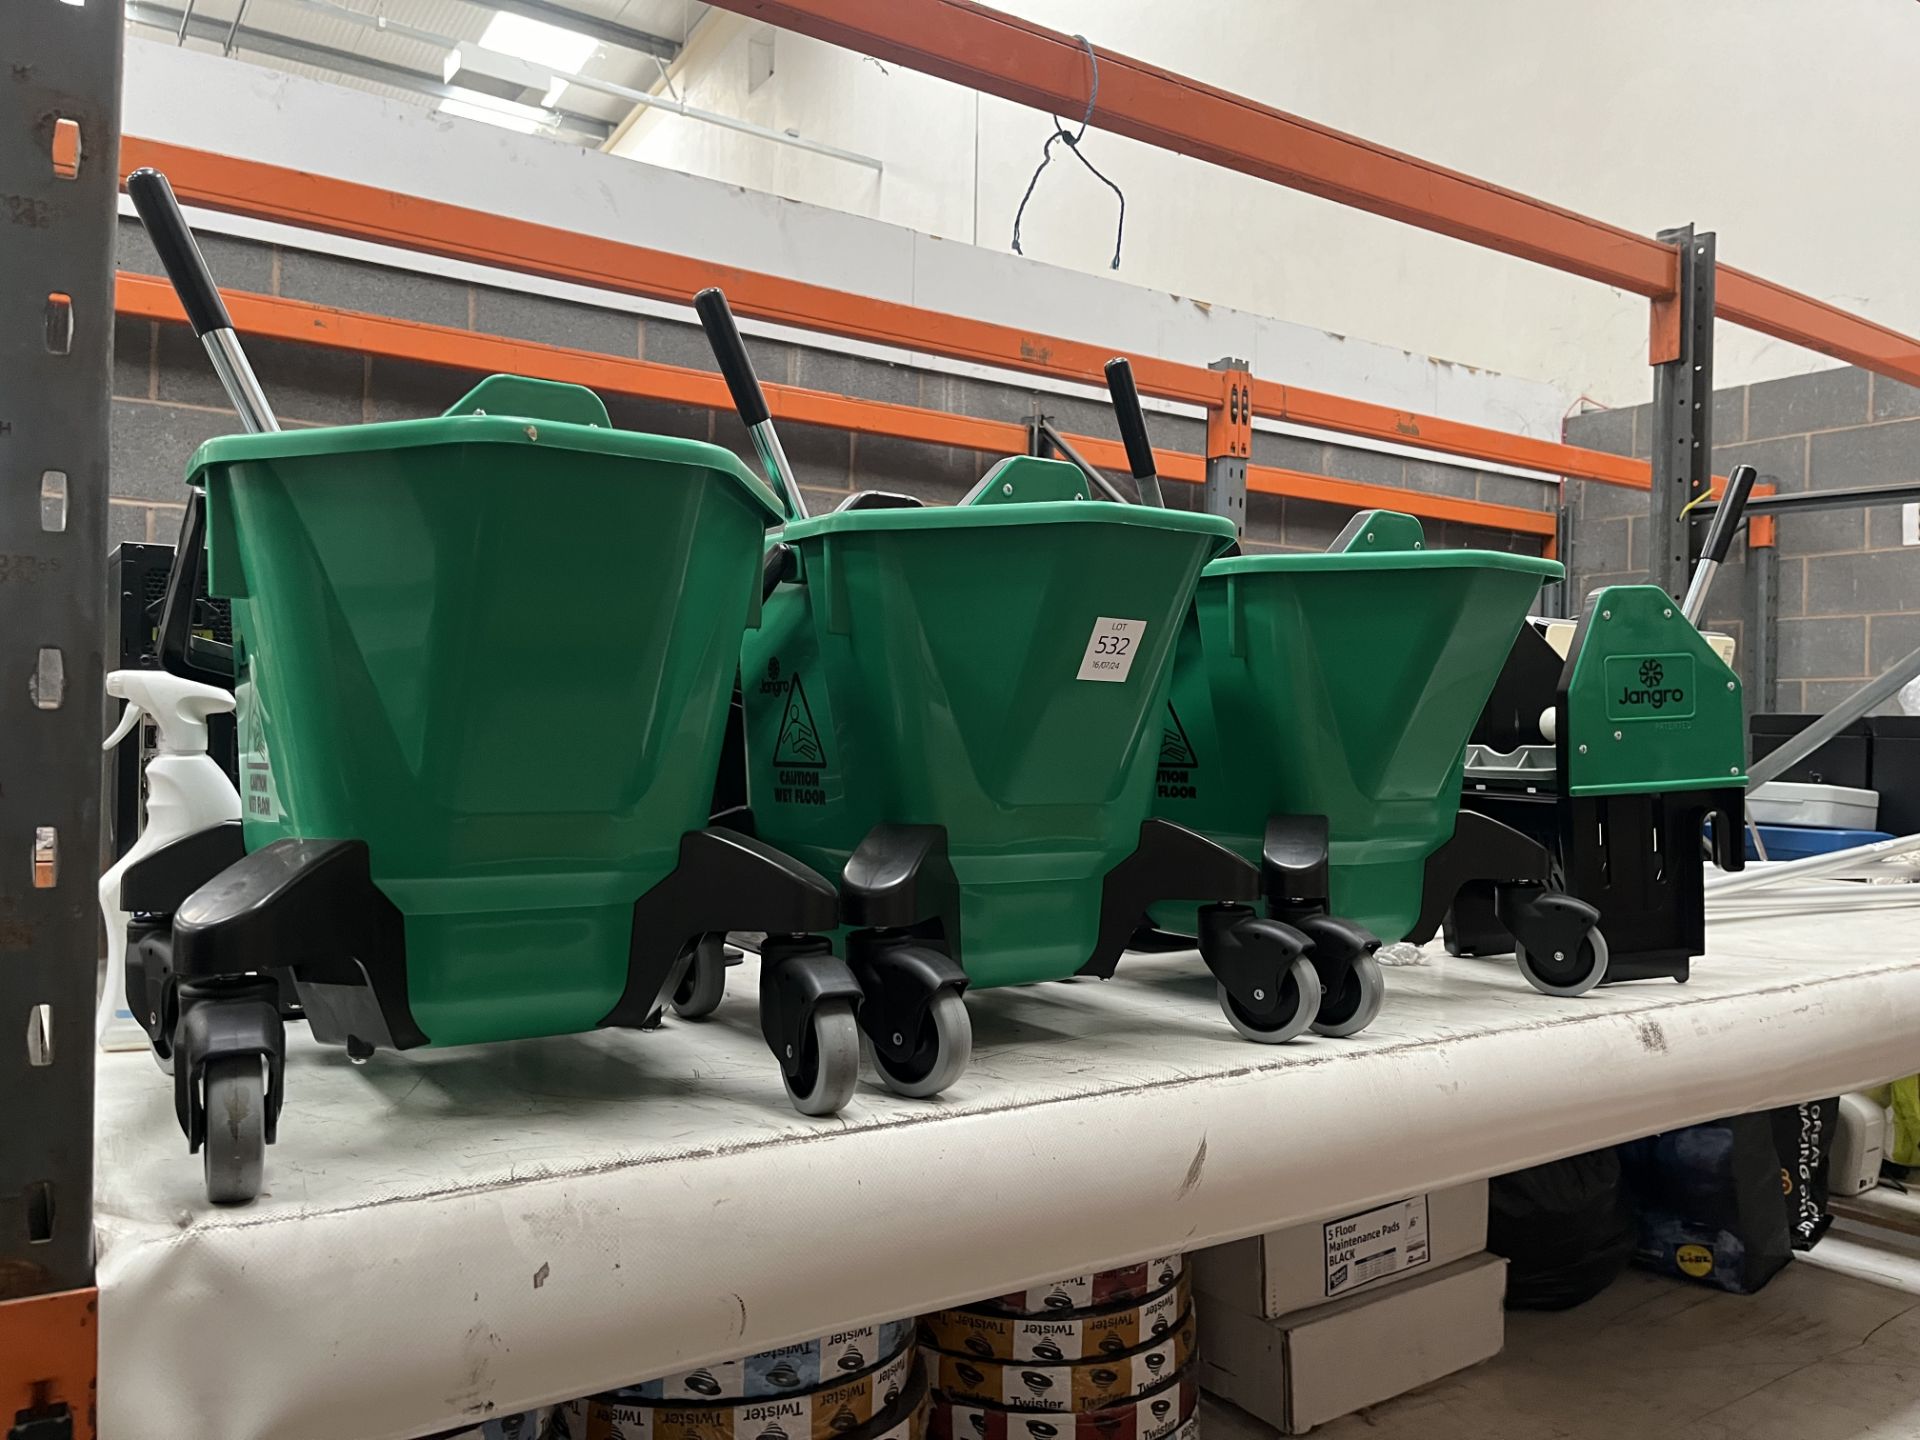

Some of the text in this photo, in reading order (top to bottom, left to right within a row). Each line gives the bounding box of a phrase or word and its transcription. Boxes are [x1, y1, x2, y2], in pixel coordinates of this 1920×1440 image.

[1112, 622, 1128, 631] LOT
[1095, 636, 1130, 655] 532
[1092, 661, 1120, 670] 16/07/24
[759, 678, 789, 698] Jangro
[1619, 686, 1684, 709] Jangro
[250, 773, 267, 793] CAUTION
[779, 770, 819, 786] CAUTION
[1156, 770, 1188, 784] TION
[774, 787, 826, 805] WET FLOOR
[1158, 785, 1196, 799] FLOOR
[1798, 1102, 1811, 1181] MAZING
[1328, 1222, 1357, 1241] 5 Floor
[1328, 1221, 1400, 1253] Maintenance Pads
[1329, 1250, 1356, 1267] BLACK
[1145, 1293, 1174, 1316] Twister
[958, 1315, 1006, 1334] Twister
[1022, 1323, 1075, 1336] Twister
[1089, 1313, 1134, 1330] Twister
[827, 1326, 873, 1347] Twister
[877, 1356, 907, 1384] Twister
[820, 1382, 866, 1407] Twister
[1010, 1396, 1064, 1409] Twister
[595, 1406, 644, 1426] Twiser
[662, 1411, 724, 1427] Twister
[743, 1401, 803, 1421] Twister
